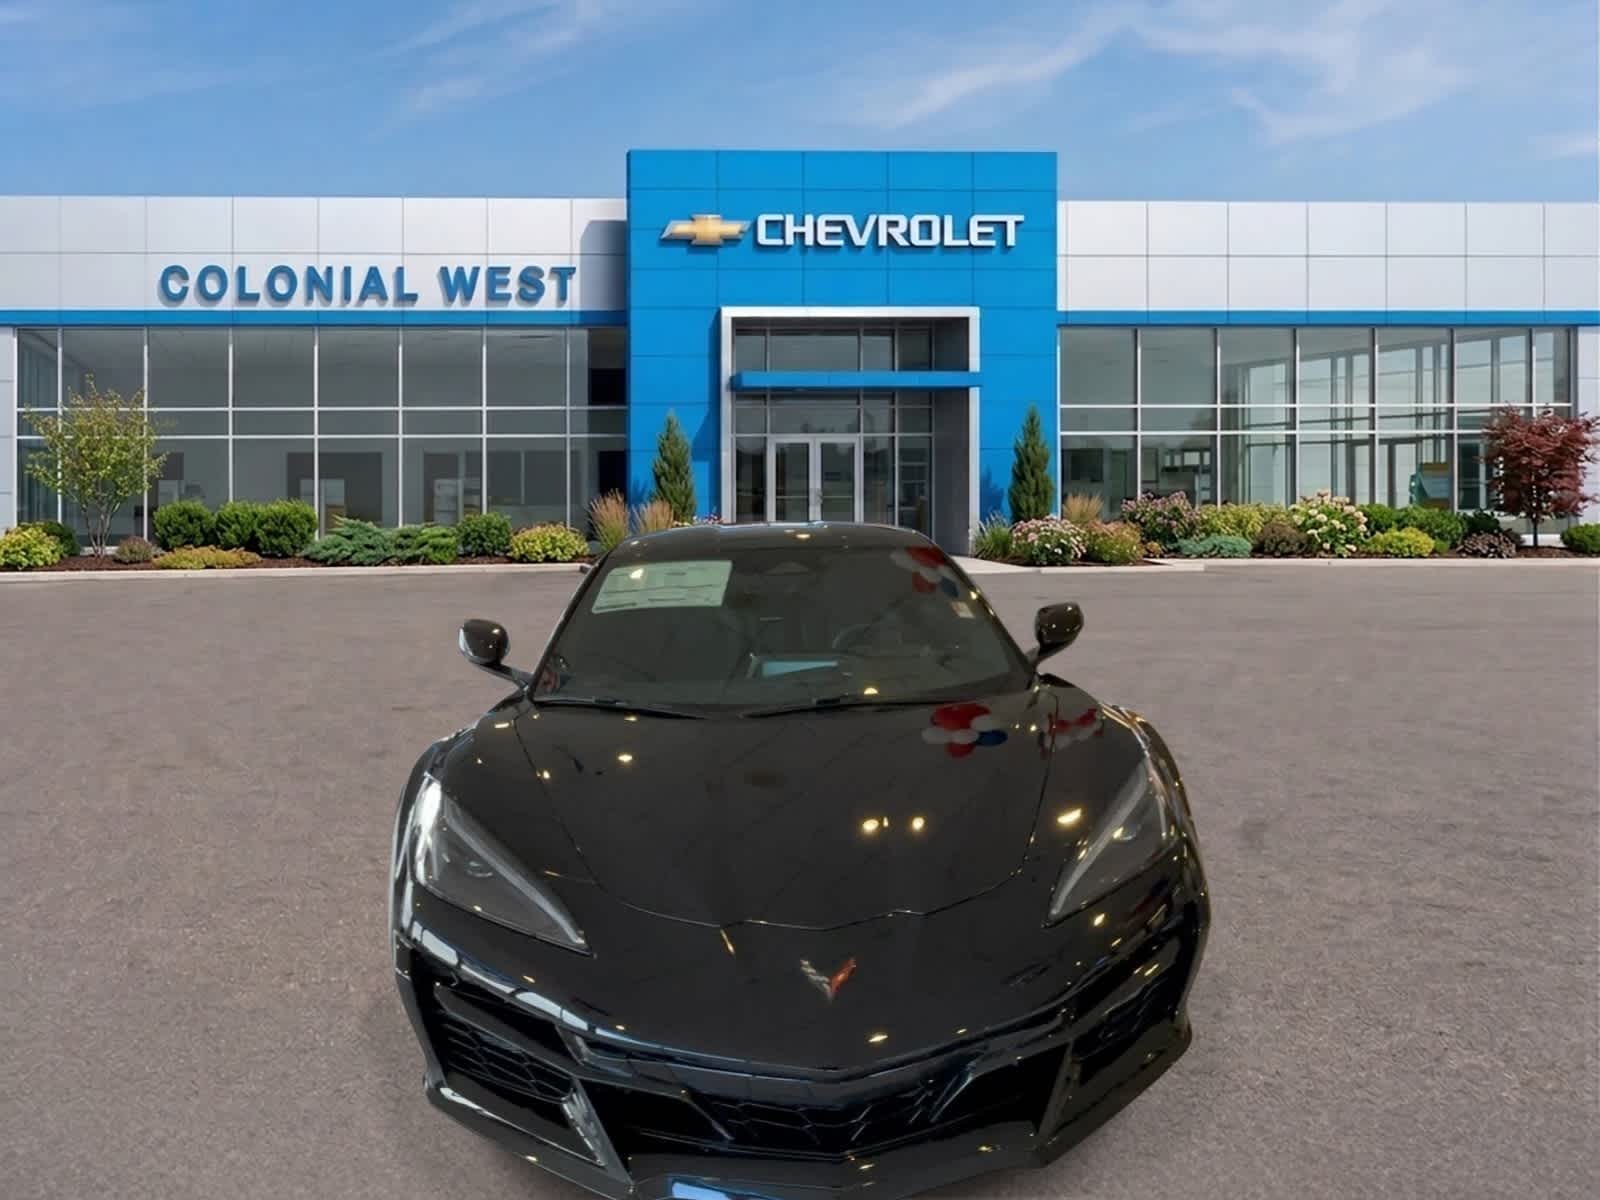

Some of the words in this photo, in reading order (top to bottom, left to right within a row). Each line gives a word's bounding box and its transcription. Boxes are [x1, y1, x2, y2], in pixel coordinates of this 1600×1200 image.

[756, 213, 1025, 248] CHEVROLET
[159, 264, 419, 304] COLONIAL
[439, 265, 577, 304] WEST
